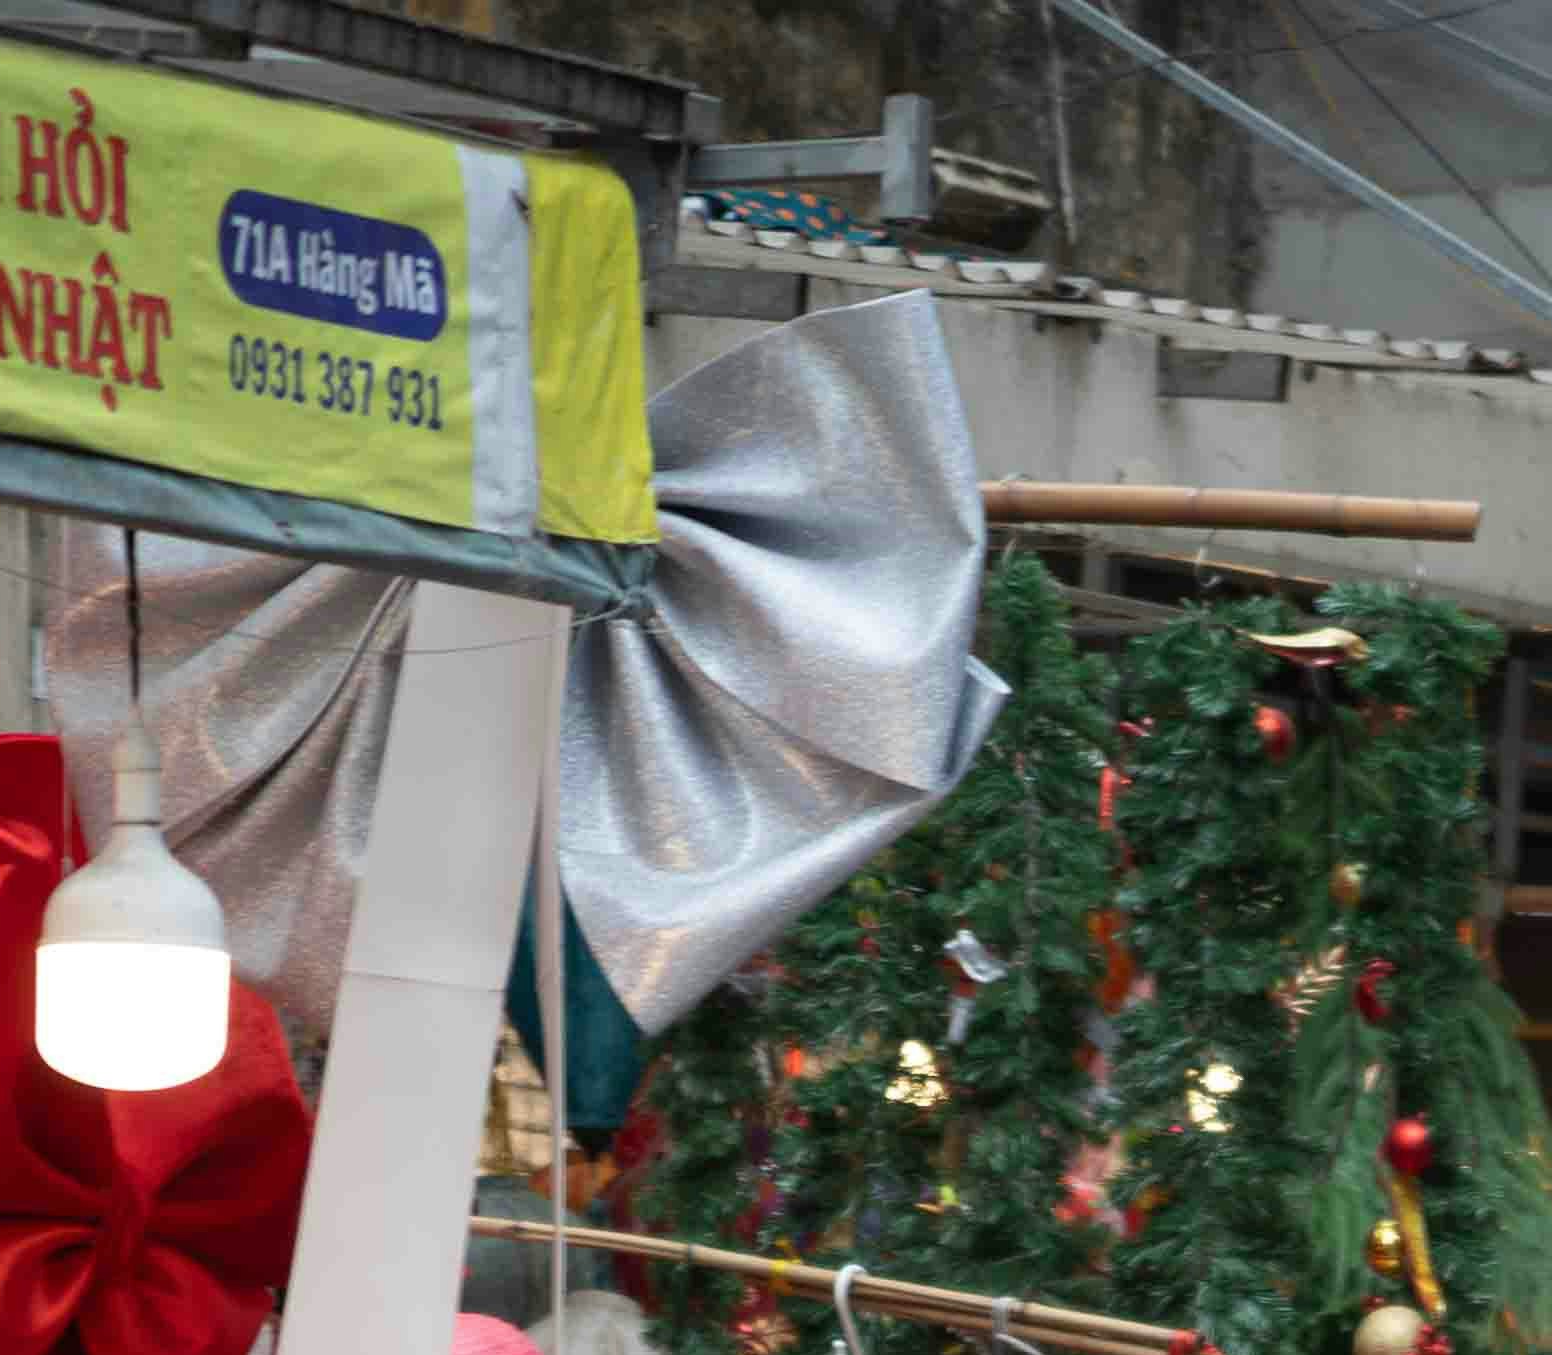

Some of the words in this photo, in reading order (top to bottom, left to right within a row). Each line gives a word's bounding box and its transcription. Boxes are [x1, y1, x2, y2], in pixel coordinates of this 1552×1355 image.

[15, 86, 133, 234] HỎI
[231, 214, 293, 285] 71A
[298, 227, 380, 316] Hàng
[384, 250, 439, 315] Mã
[228, 332, 308, 404] 0931
[317, 351, 375, 418] 387
[385, 365, 444, 431] 931
